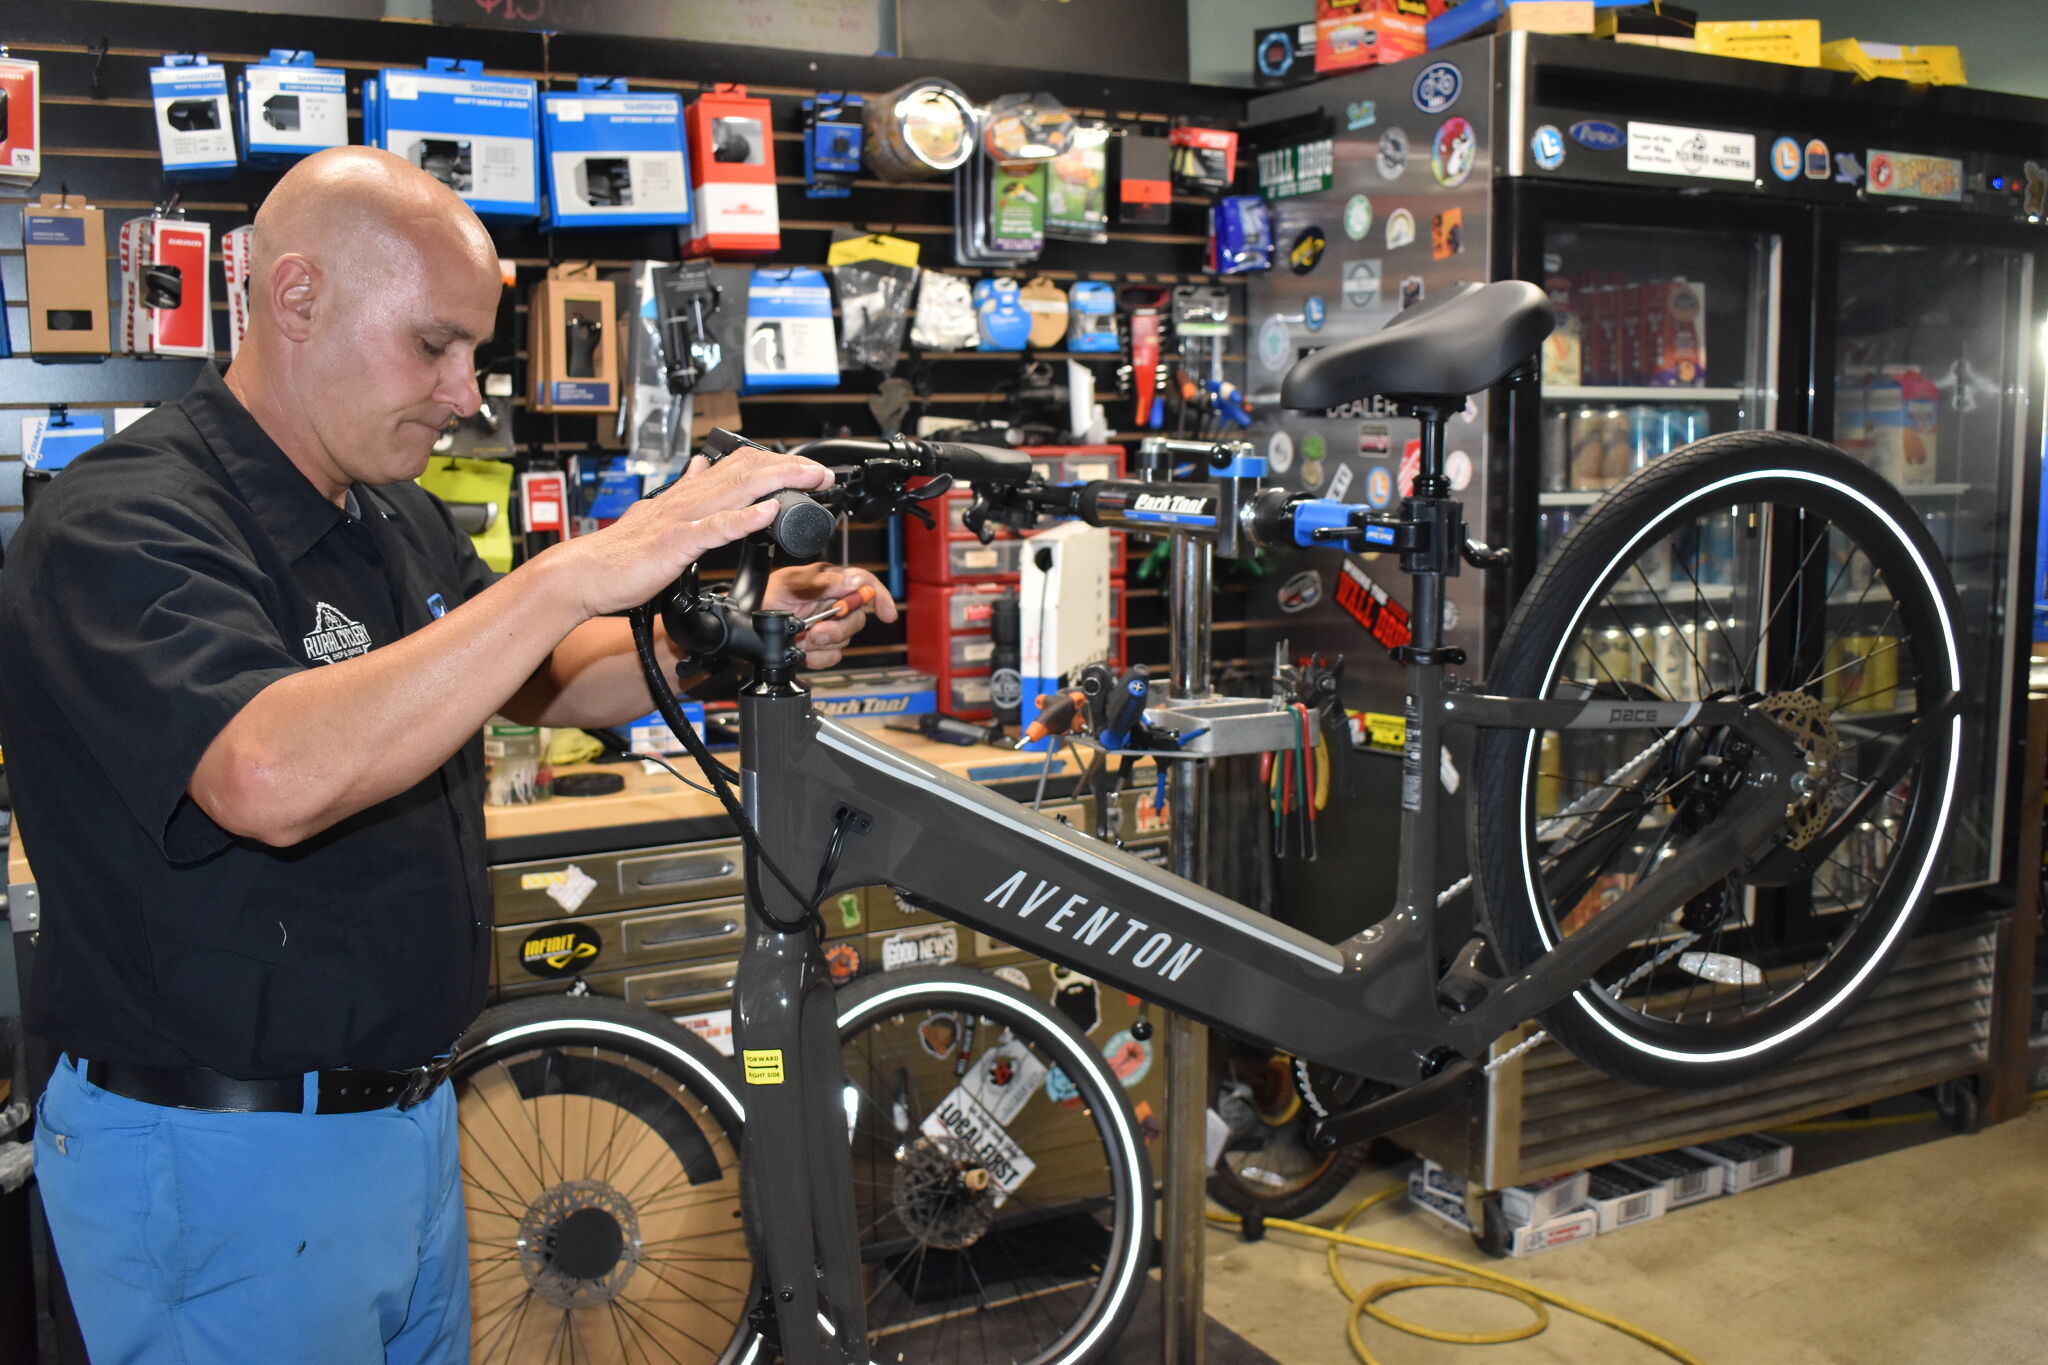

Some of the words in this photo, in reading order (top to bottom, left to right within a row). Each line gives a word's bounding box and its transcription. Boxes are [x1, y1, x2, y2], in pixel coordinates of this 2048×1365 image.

[470, 83, 528, 96] SHIMANO
[1134, 493, 1171, 511] Park
[1170, 495, 1208, 515] Tool
[304, 631, 343, 659] RURAL
[335, 624, 371, 650] CYCLERY
[861, 695, 911, 713] Tool
[1609, 708, 1658, 724] pace
[984, 870, 1202, 982] AVENTON
[887, 940, 918, 967] GOOD
[918, 934, 953, 961] NEWS
[940, 1103, 982, 1147] LOCAL
